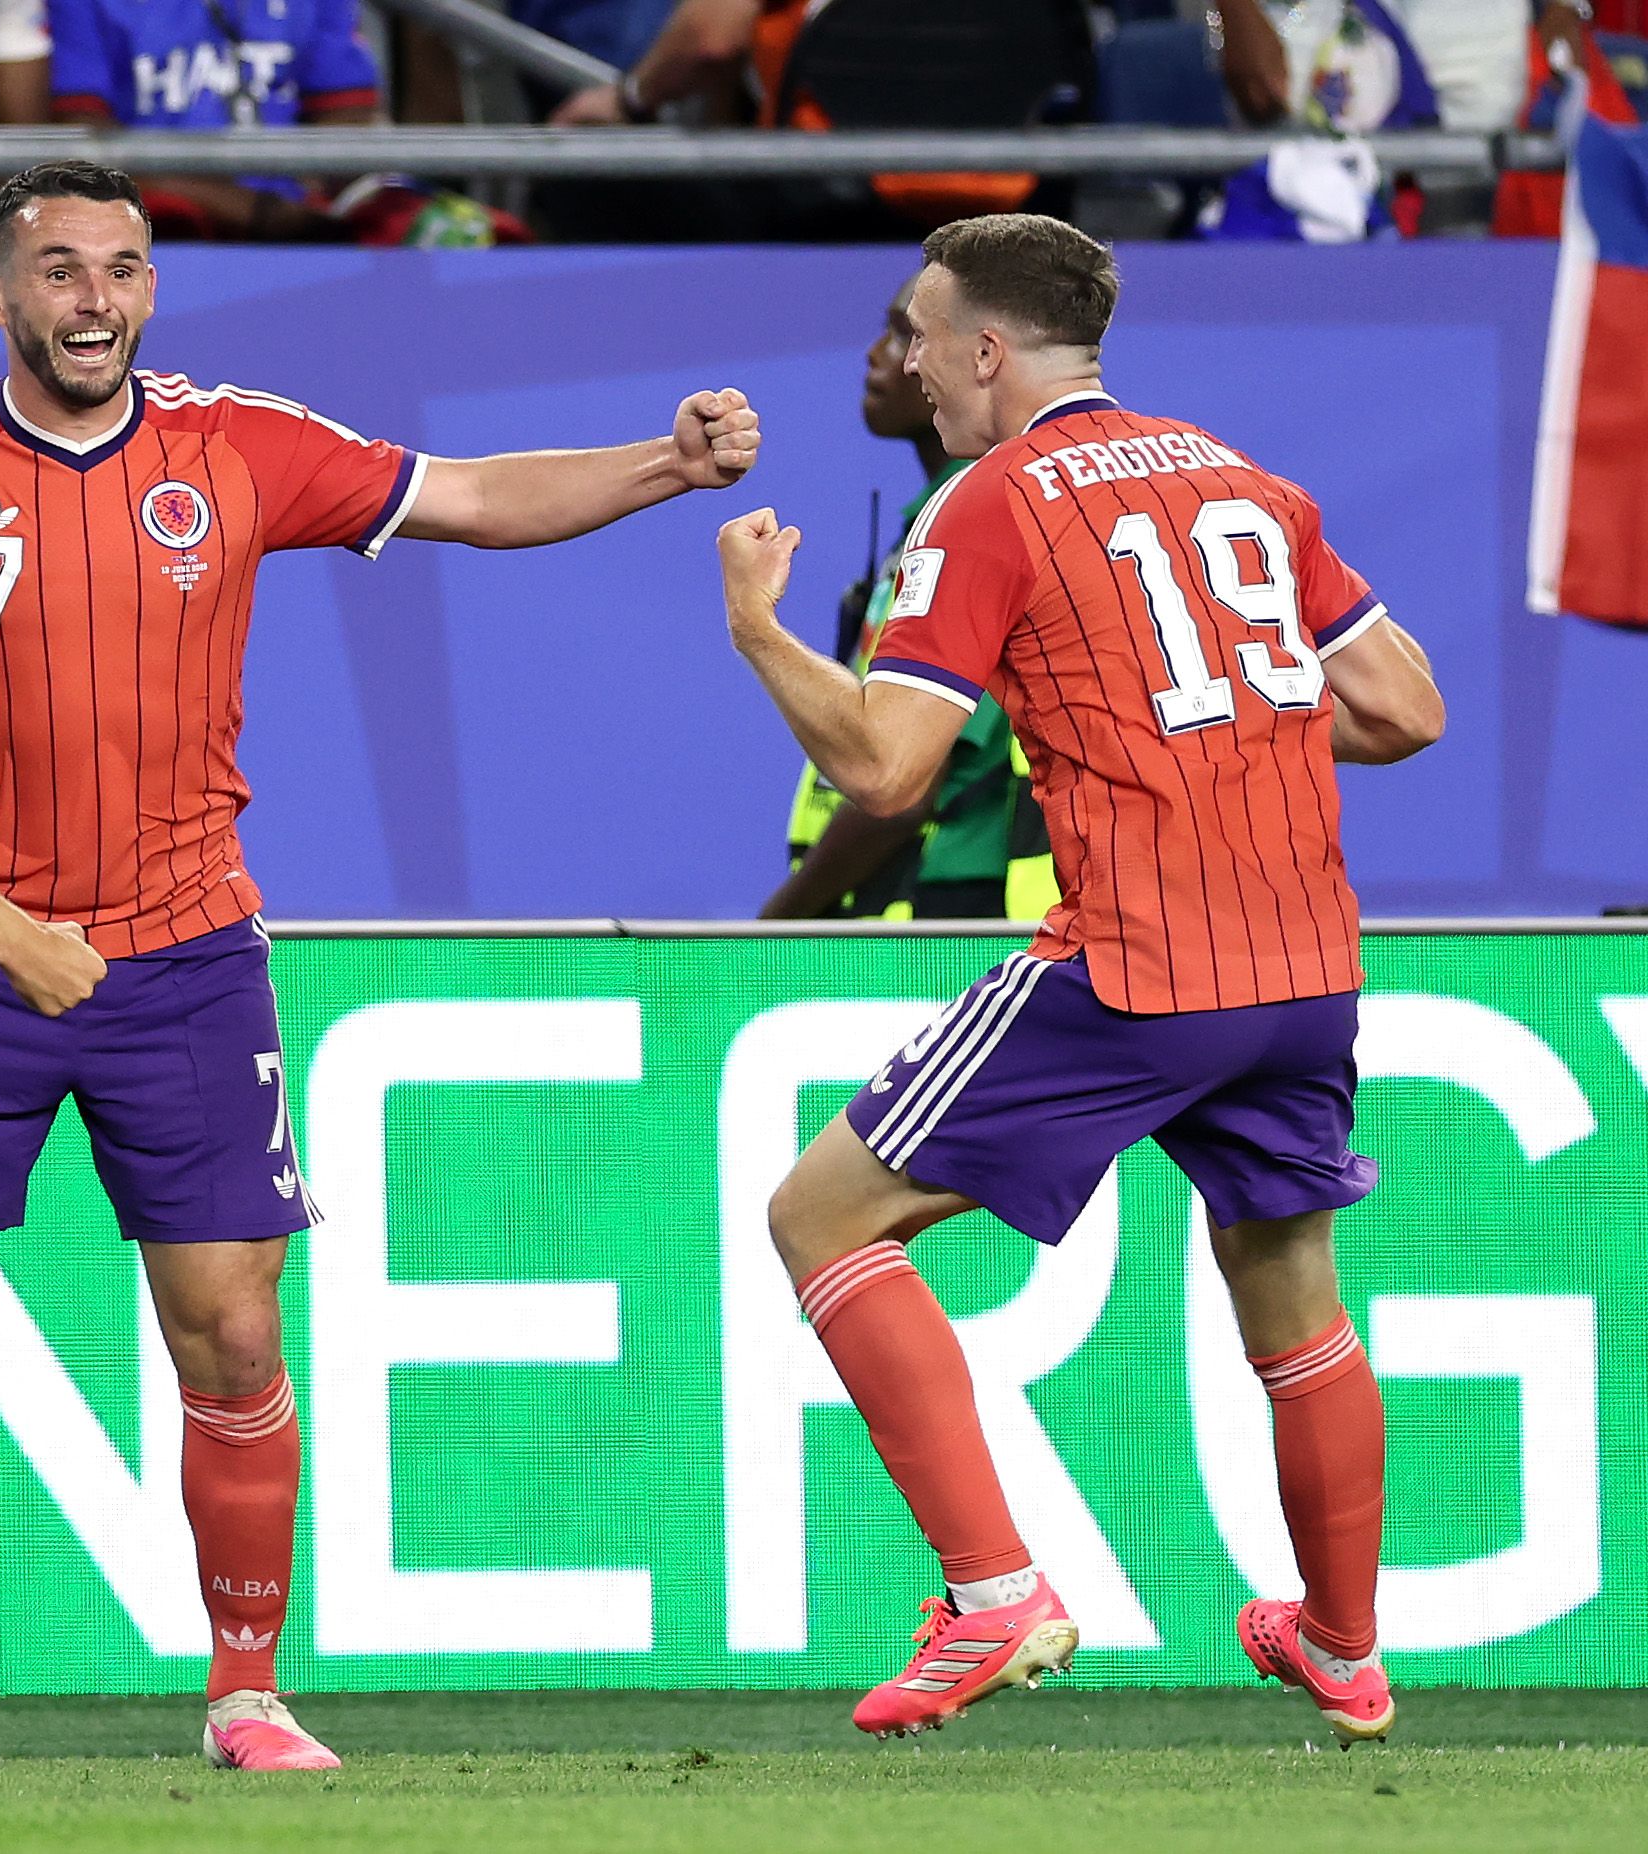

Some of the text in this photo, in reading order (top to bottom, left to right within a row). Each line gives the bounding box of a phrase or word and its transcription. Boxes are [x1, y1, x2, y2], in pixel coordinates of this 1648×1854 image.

[1022, 432, 1254, 502] FERGUSON
[1106, 498, 1326, 736] 19
[253, 1051, 288, 1155] 7
[212, 1575, 282, 1598] ALBA
